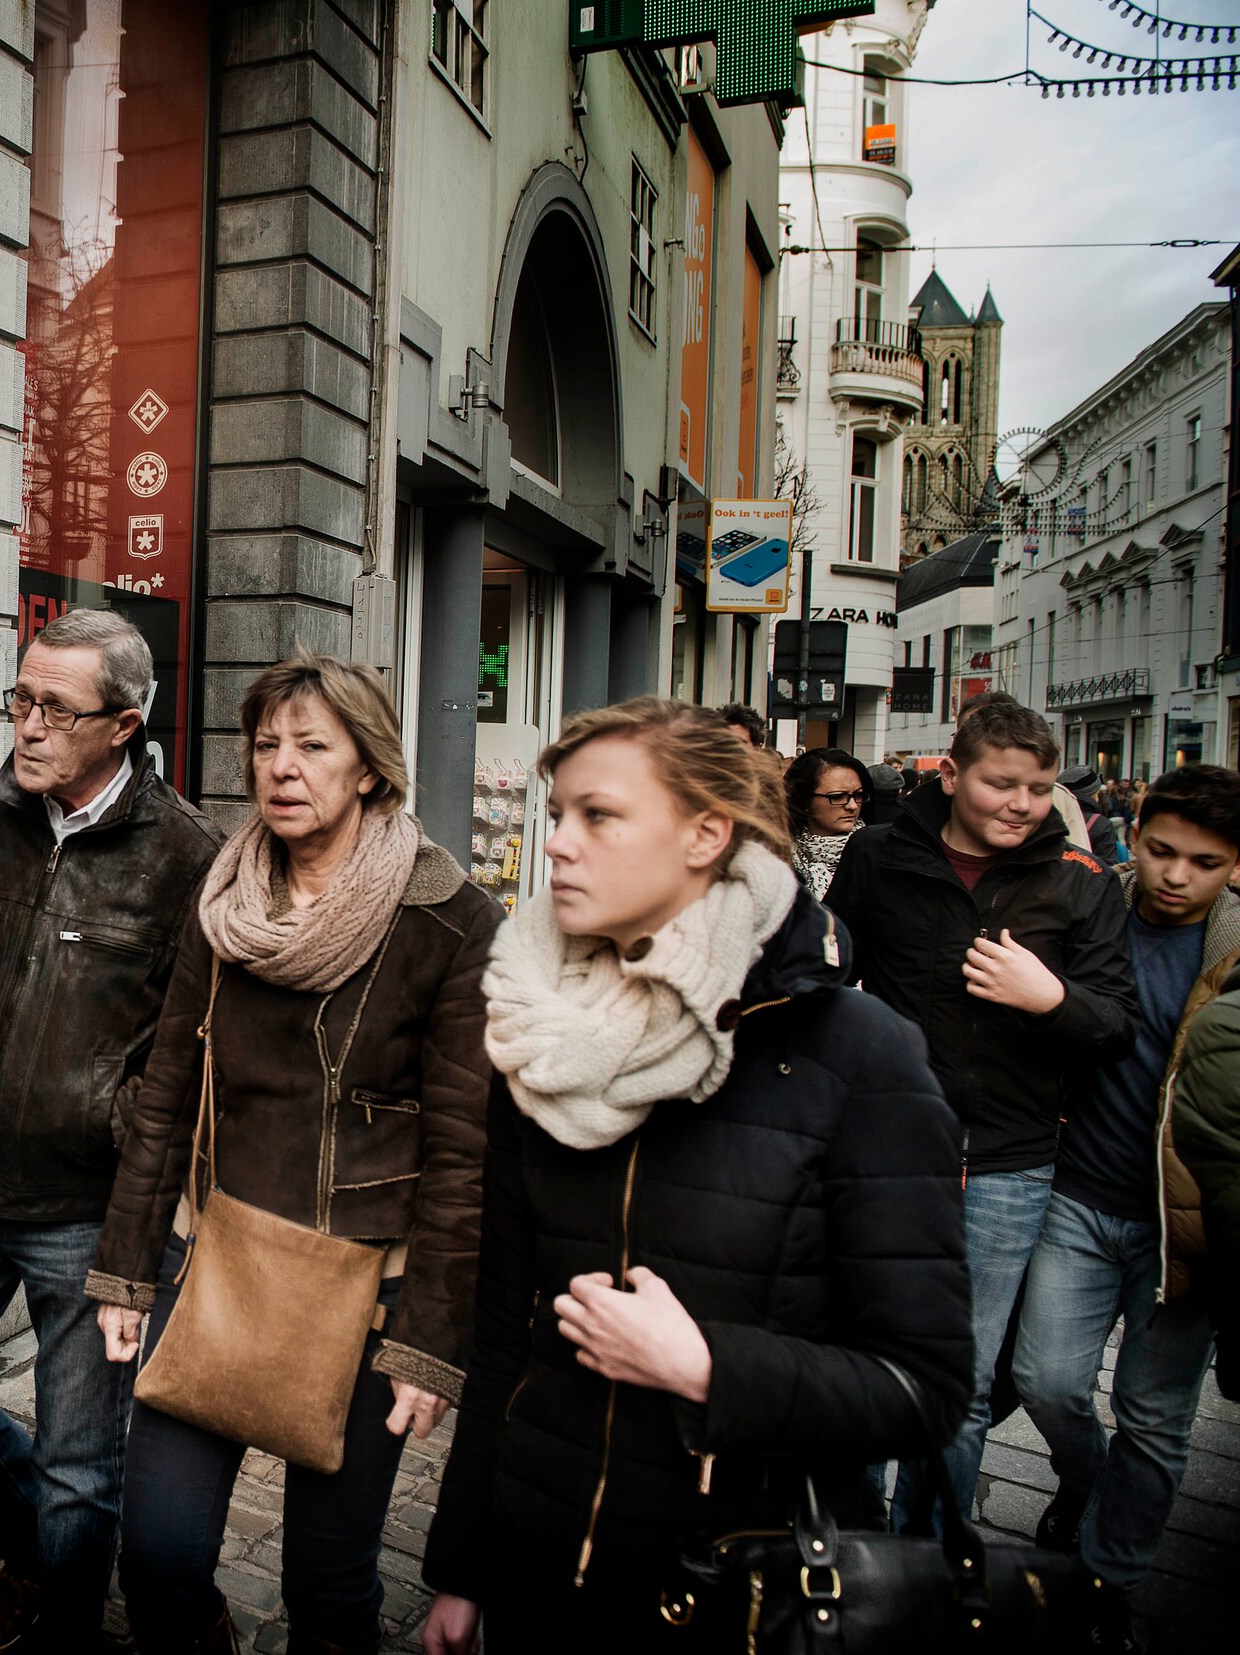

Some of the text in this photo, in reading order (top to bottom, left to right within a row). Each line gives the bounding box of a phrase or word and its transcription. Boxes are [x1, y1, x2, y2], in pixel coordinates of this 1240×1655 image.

[714, 509, 737, 518] Ook
[740, 509, 750, 517] in
[763, 509, 789, 519] geel!
[135, 518, 157, 527] celio
[810, 607, 869, 623] ZARA
[895, 692, 929, 700] ZARA
[894, 702, 929, 710] HOME
